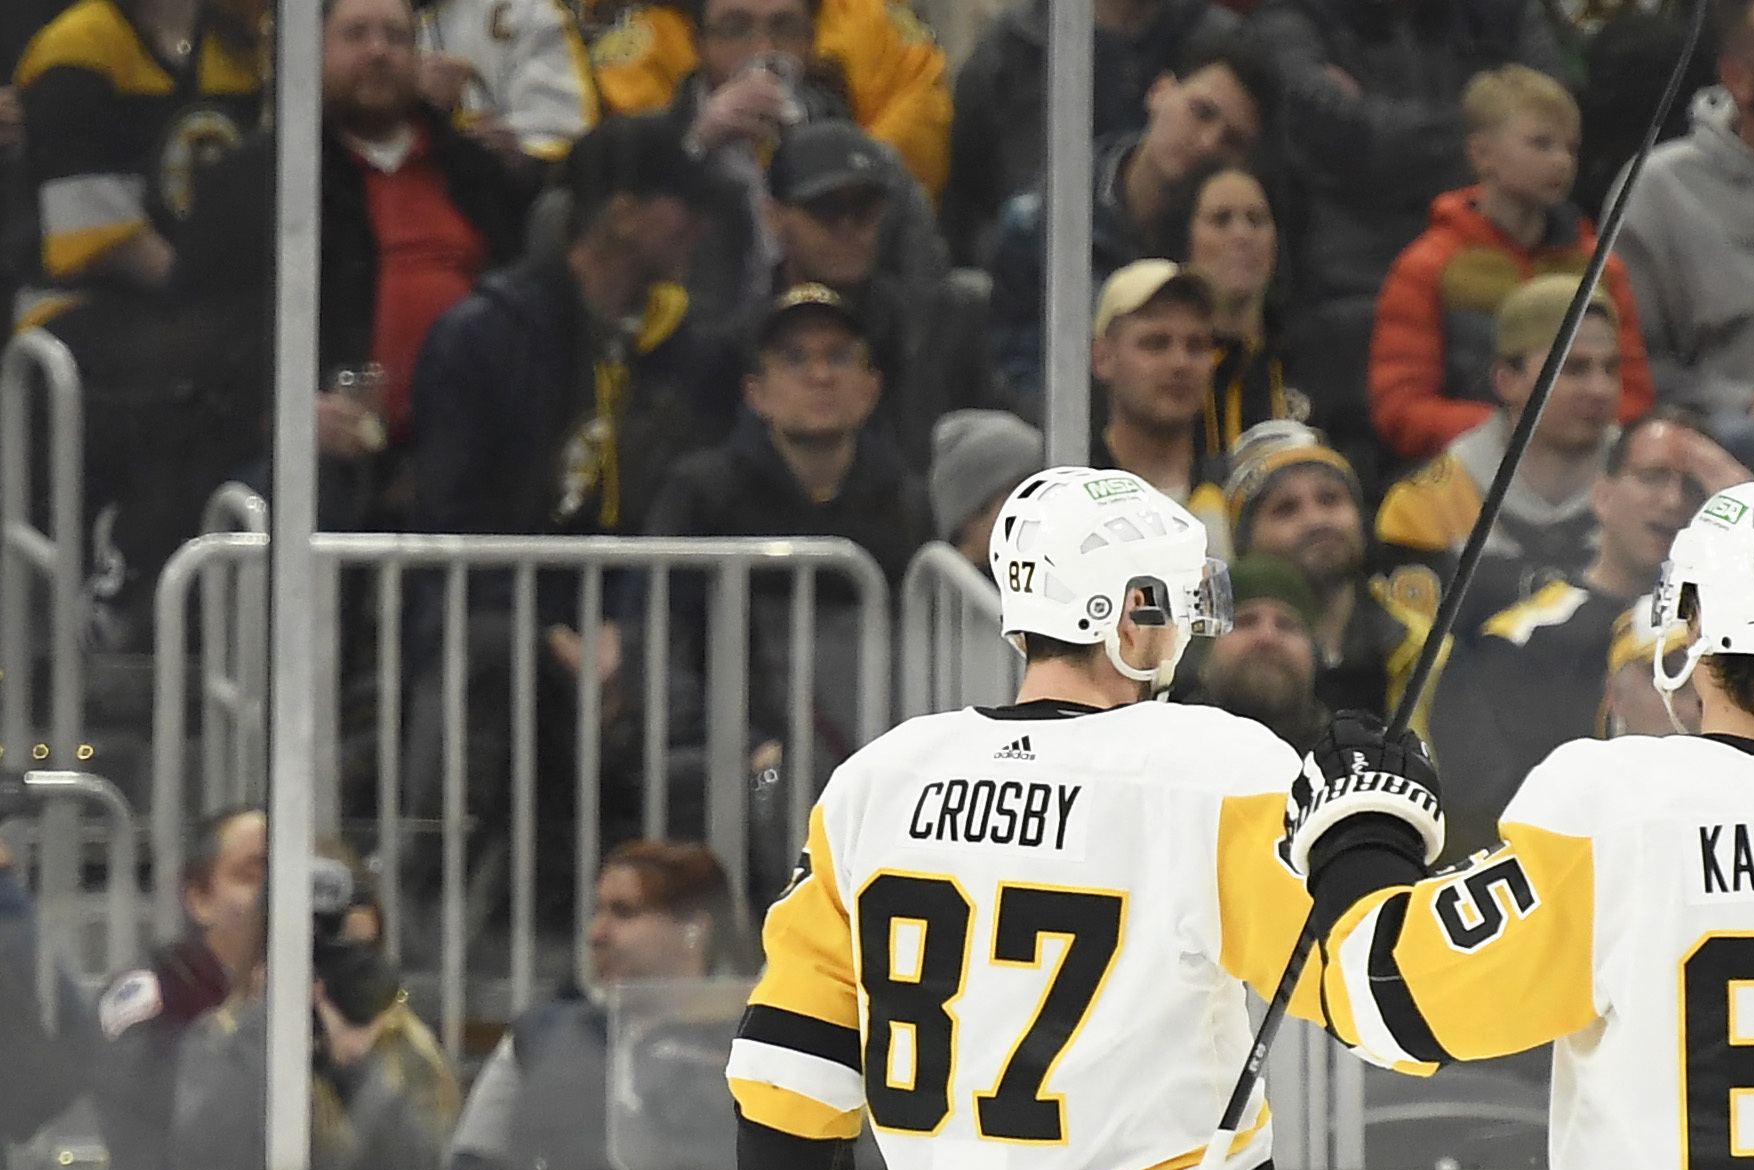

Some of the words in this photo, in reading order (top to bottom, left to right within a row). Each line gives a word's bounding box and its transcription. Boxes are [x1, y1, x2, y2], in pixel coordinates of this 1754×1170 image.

[1008, 560, 1036, 593] 87
[993, 749, 1036, 761] adidas
[909, 779, 1082, 850] CROSBY
[854, 866, 1131, 1146] 87
